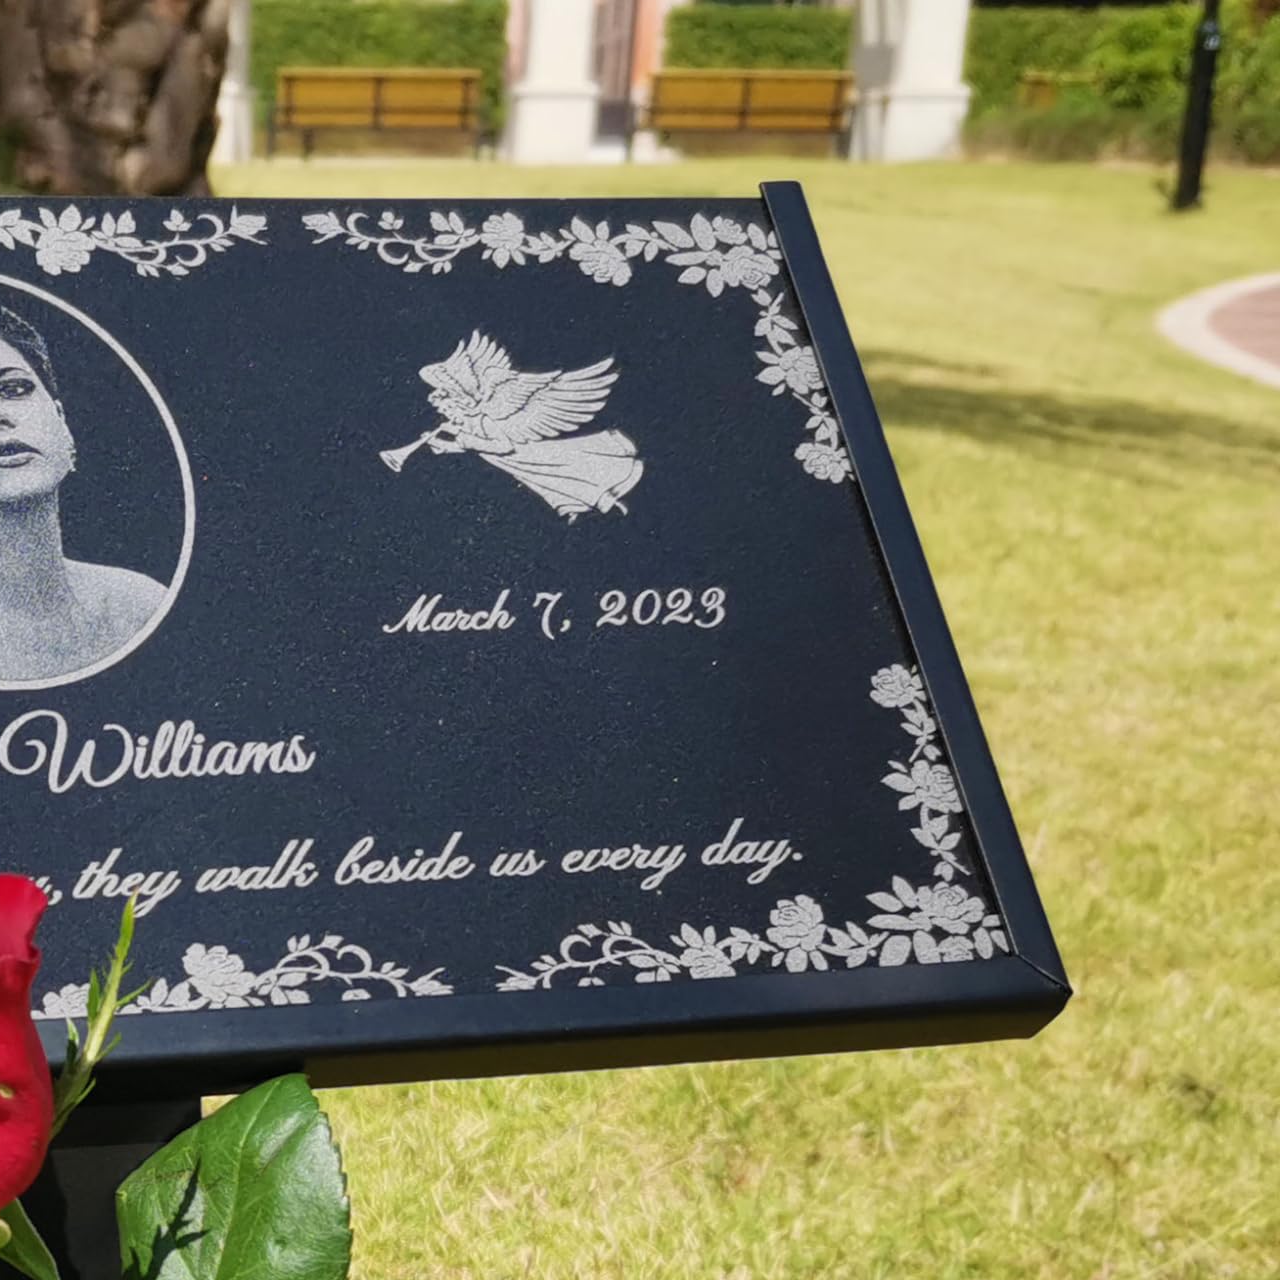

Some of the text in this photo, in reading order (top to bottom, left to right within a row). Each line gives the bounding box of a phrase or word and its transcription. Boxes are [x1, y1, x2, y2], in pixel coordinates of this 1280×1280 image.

[377, 588, 726, 639] March 7, 2023
[72, 847, 182, 918] they
[195, 839, 318, 892] walk
[335, 832, 475, 885] beside
[490, 850, 545, 876] us
[562, 844, 686, 890] every
[702, 818, 804, 885] day.
